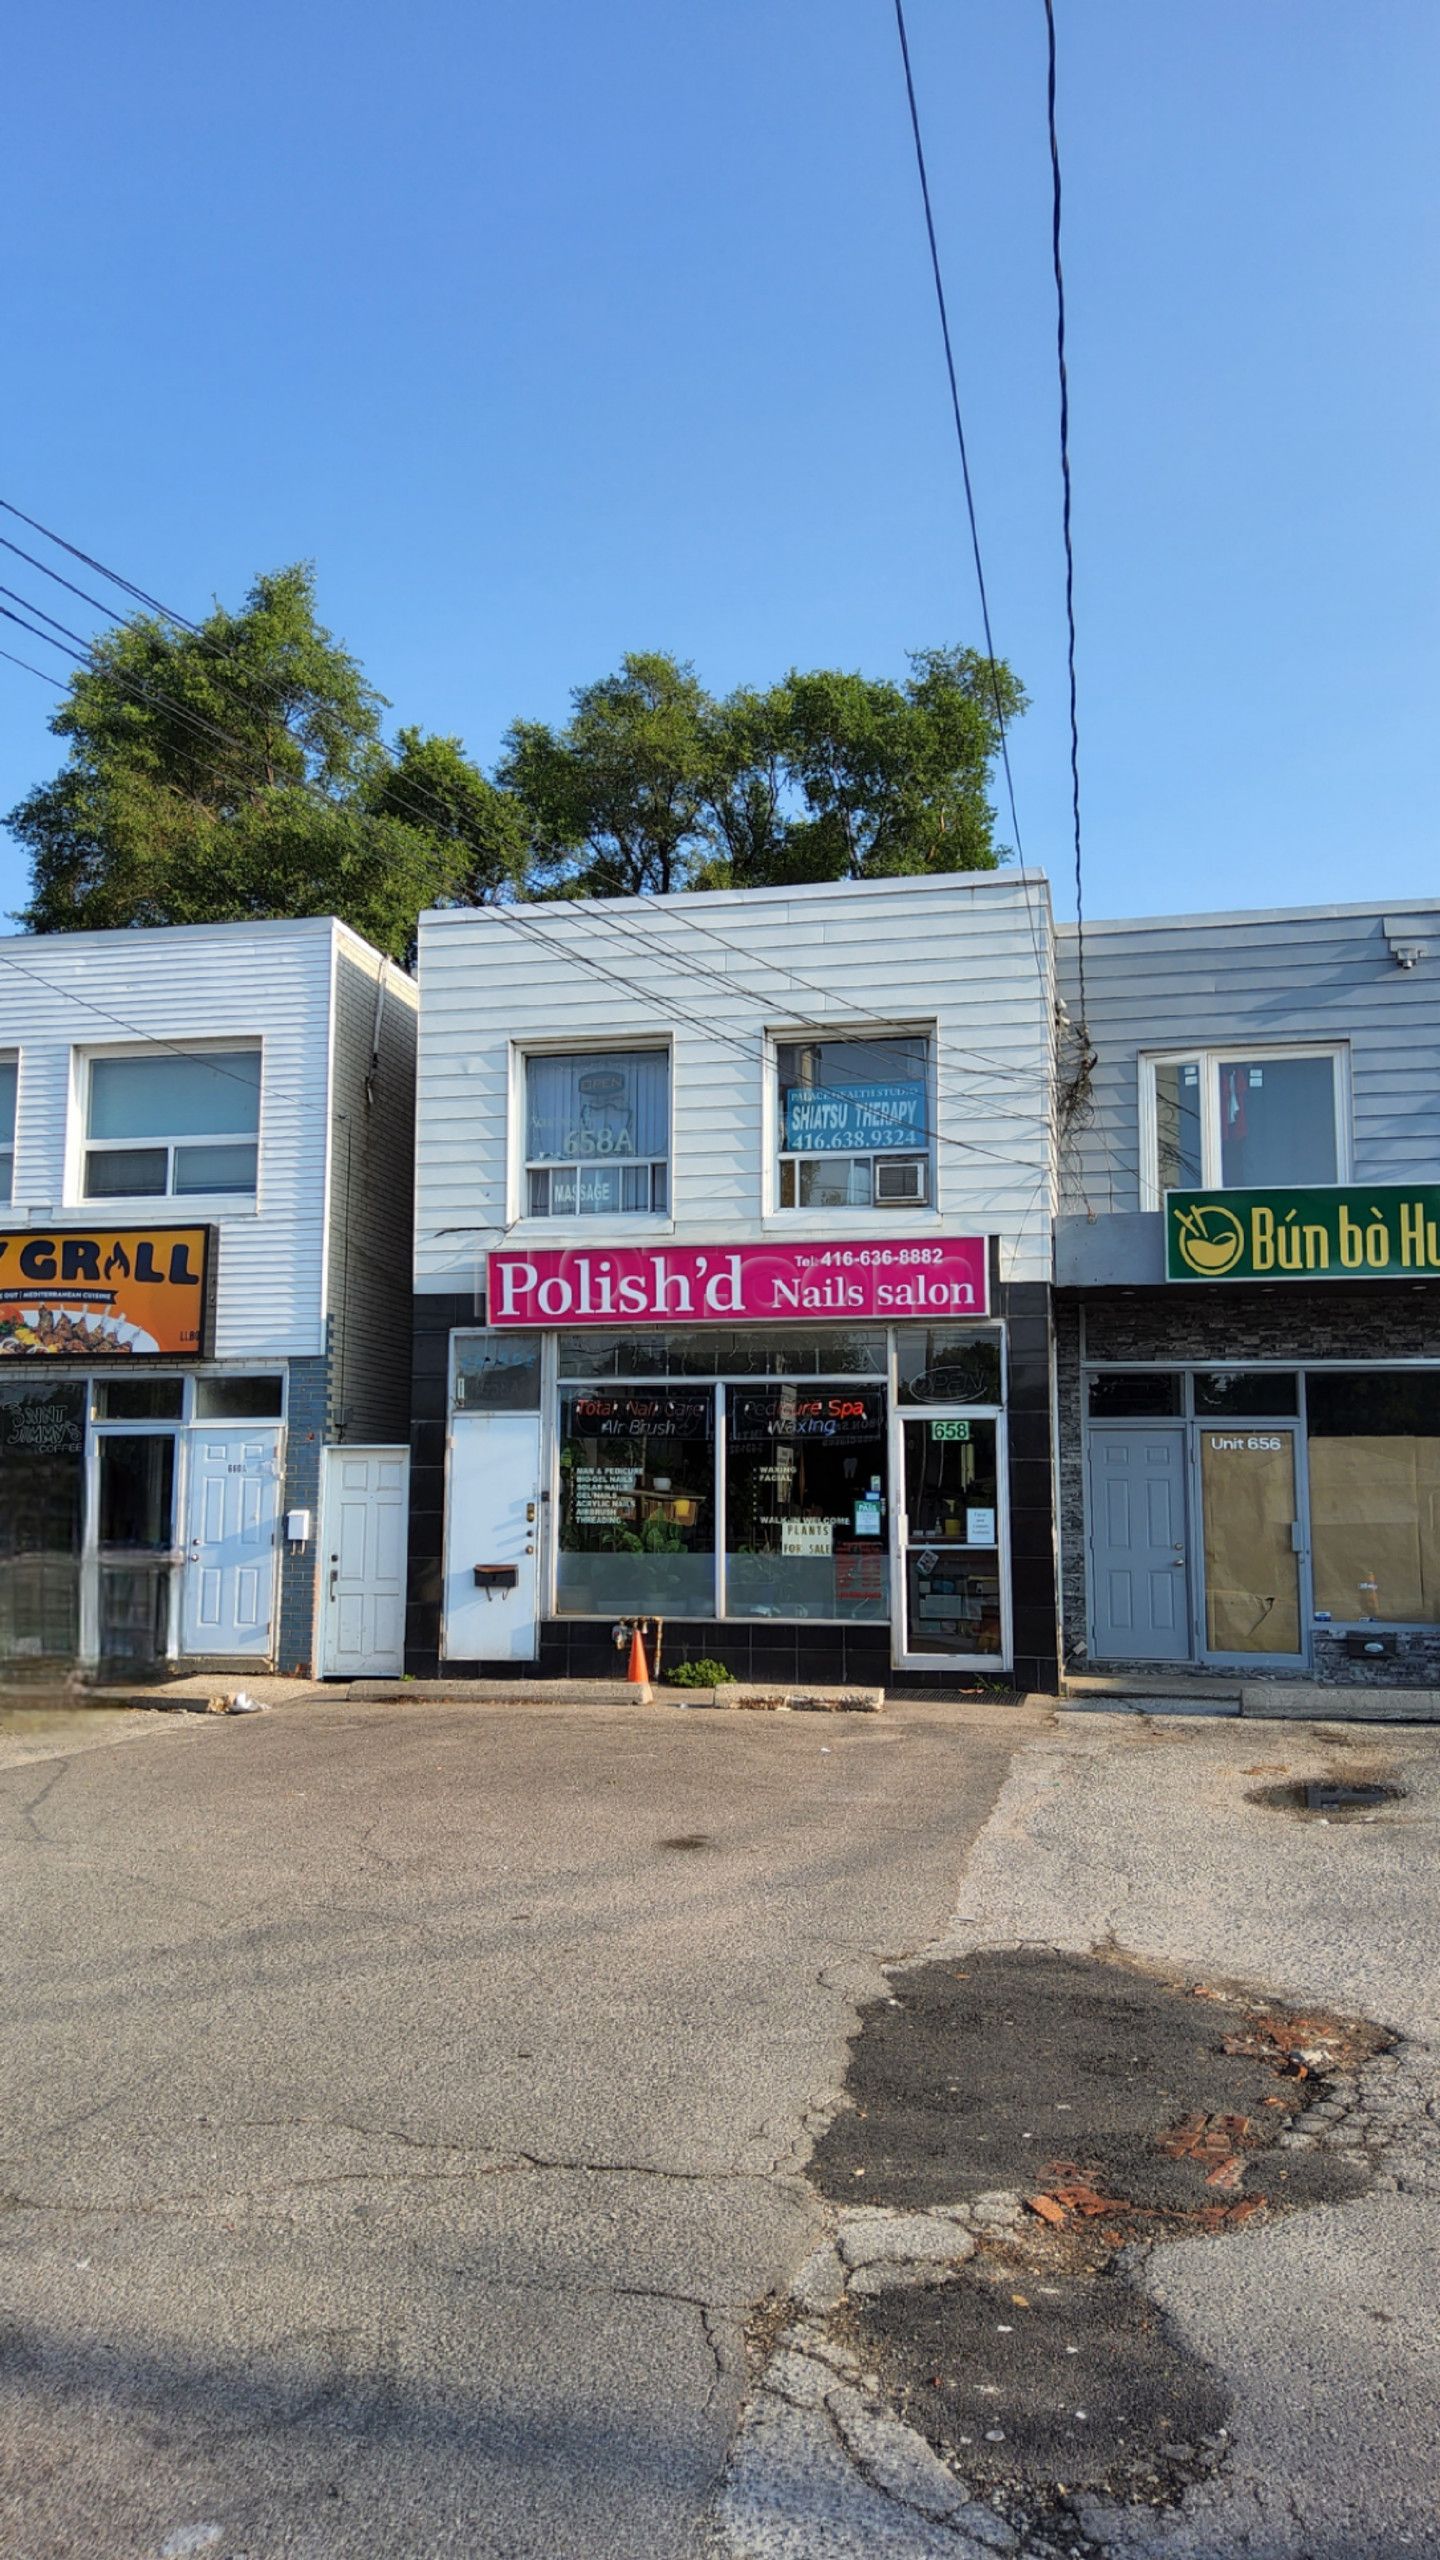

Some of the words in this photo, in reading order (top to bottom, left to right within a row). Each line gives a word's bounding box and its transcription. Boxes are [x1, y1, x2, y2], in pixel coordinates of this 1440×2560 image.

[792, 1103, 848, 1131] SHIATSU
[855, 1100, 917, 1128] THERAPY
[563, 1128, 634, 1154] 658A
[792, 1129, 917, 1150] 416.638.9324
[554, 1183, 610, 1203] MASSAGE
[1251, 1206, 1329, 1270] Bún
[1338, 1204, 1389, 1268] bò
[820, 1248, 943, 1267] 416-636-8882
[23, 1290, 81, 1298] MEDITERRANEAN
[496, 1255, 747, 1316] Polish'd
[771, 1276, 864, 1308] Nails
[877, 1274, 976, 1305] salon
[578, 1400, 616, 1416] Total
[745, 1400, 821, 1417] Pedicure
[828, 1399, 865, 1419] Spa
[629, 1419, 676, 1435] Brush
[768, 1418, 837, 1436] Waxing
[935, 1423, 967, 1439] 658
[39, 1443, 82, 1453] COFFEE
[1211, 1437, 1244, 1450] Unit
[1247, 1437, 1281, 1450] 656
[759, 1474, 792, 1482] FACIAL
[760, 1466, 797, 1474] WAXING
[787, 1524, 830, 1536] PLANTS
[783, 1544, 801, 1554] FOR
[809, 1543, 831, 1554] SALE
